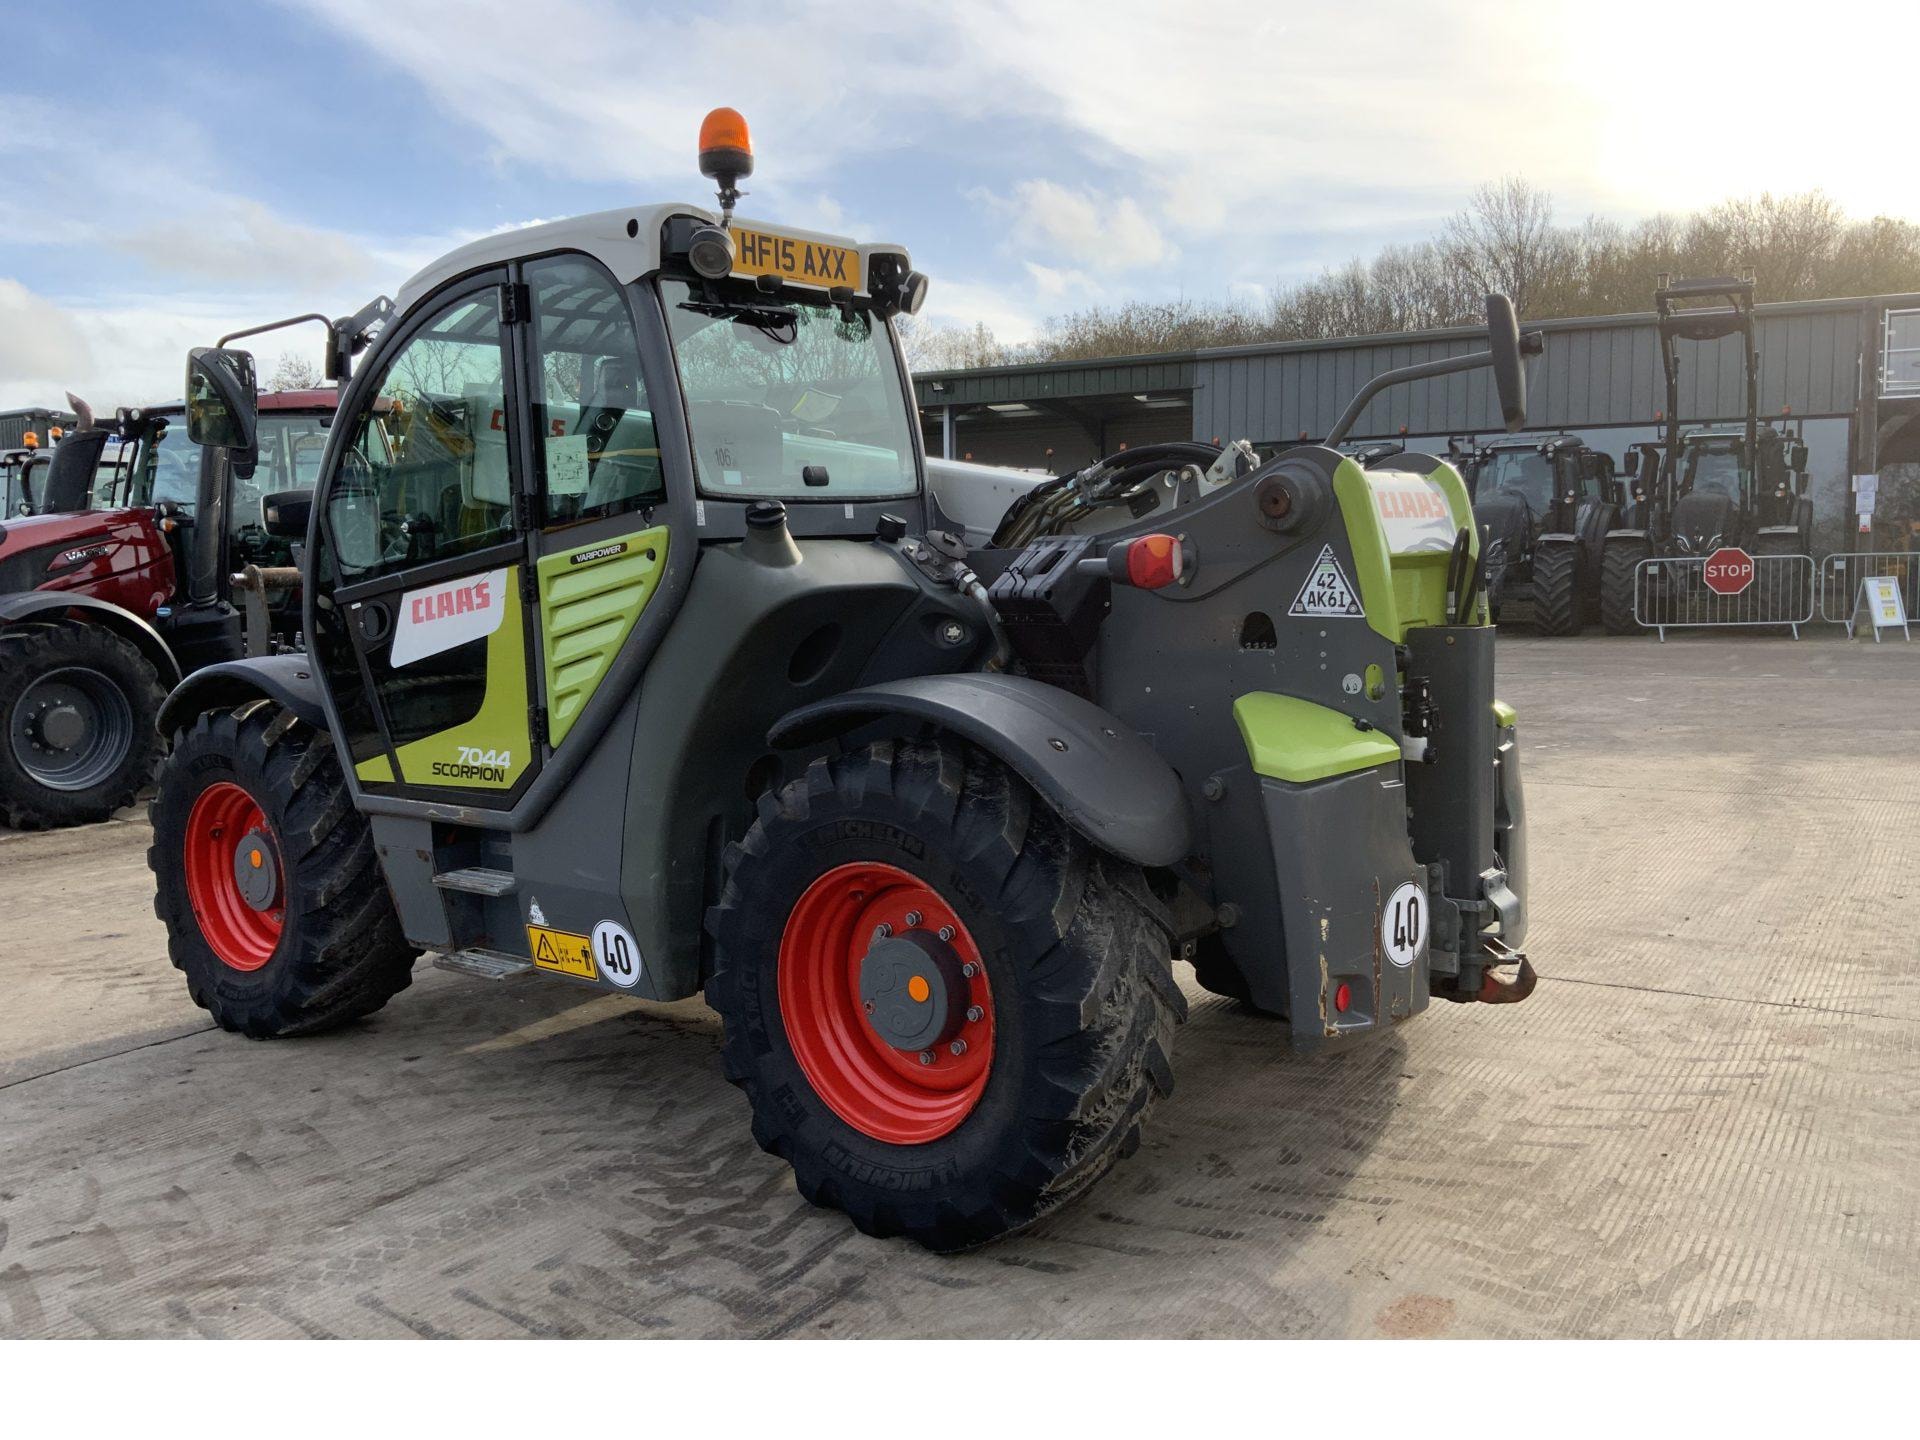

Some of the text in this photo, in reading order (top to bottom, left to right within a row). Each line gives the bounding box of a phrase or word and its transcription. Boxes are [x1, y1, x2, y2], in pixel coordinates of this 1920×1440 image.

[741, 231, 847, 281] HF15 AXX
[1379, 491, 1445, 518] CLAAS
[576, 544, 622, 562] VARIPOWER
[1317, 573, 1336, 589] 42
[1708, 564, 1751, 577] STOP
[412, 582, 490, 624] CLAAS
[458, 746, 511, 768] 7044
[432, 762, 505, 782] SCORPION
[1394, 897, 1419, 951] 40
[602, 932, 632, 975] 40
